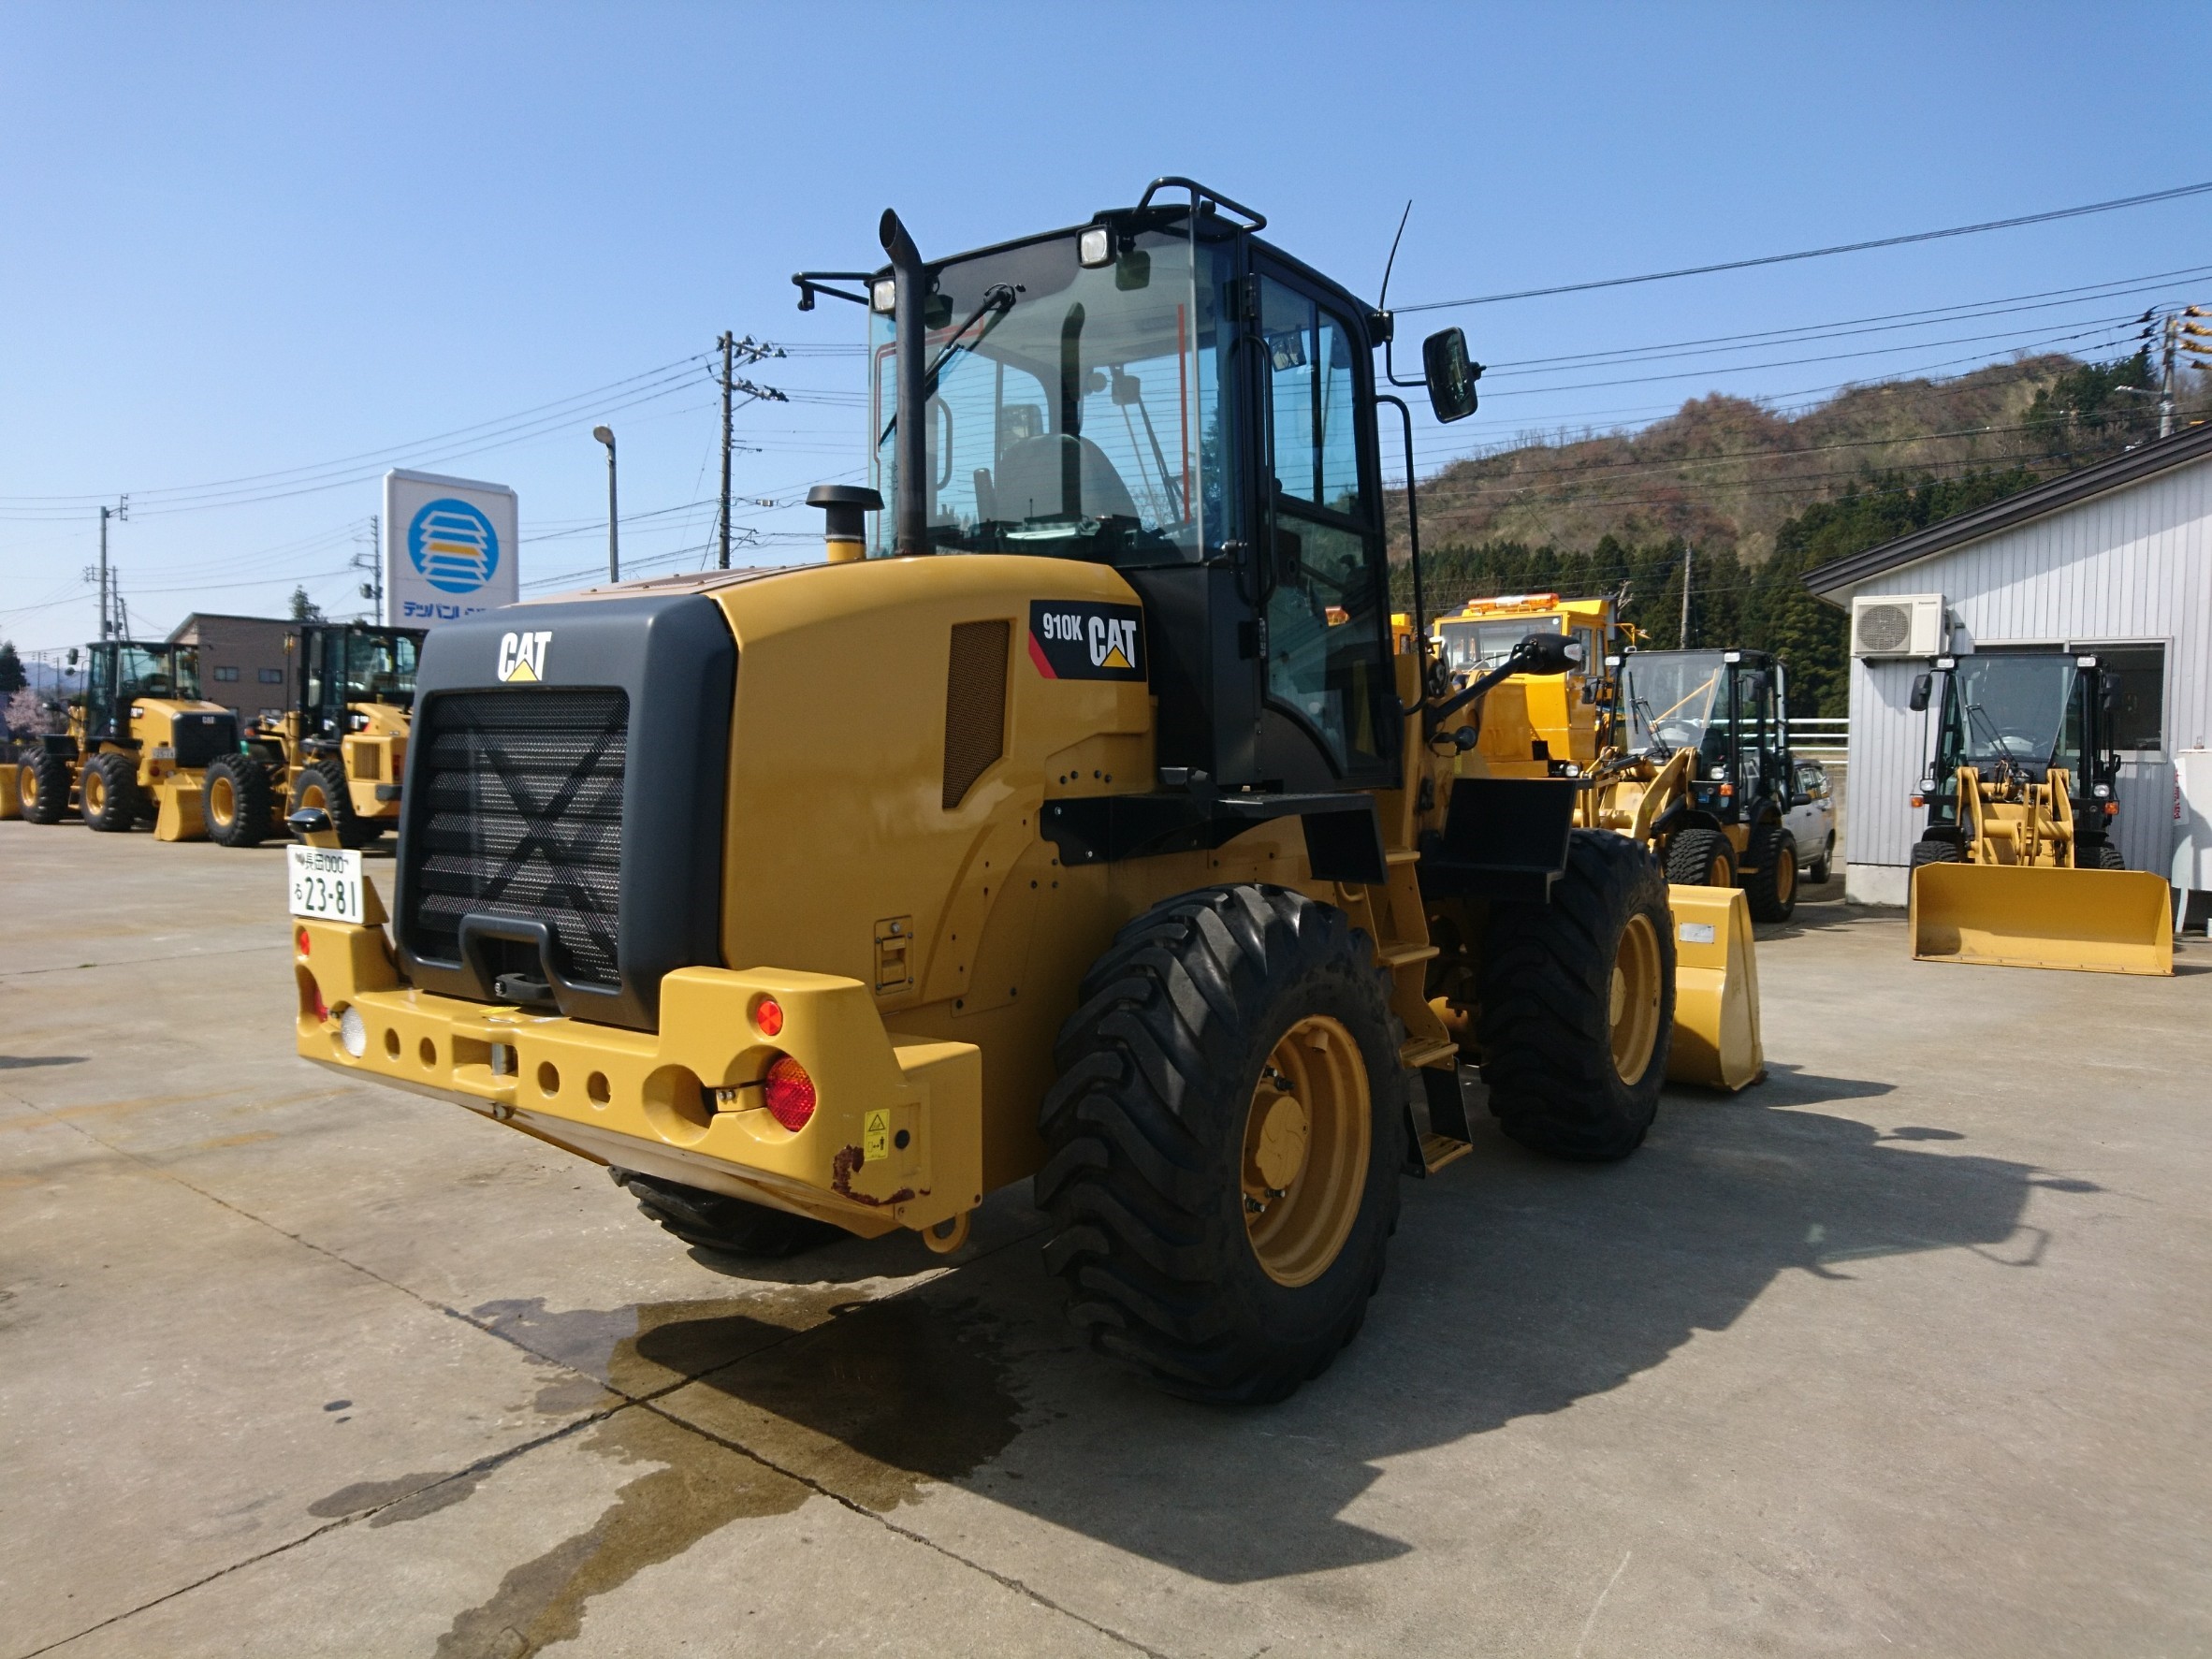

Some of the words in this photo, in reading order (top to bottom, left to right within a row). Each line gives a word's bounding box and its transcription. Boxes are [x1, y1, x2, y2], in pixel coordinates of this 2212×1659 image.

[498, 631, 553, 682] CAT
[1042, 612, 1084, 641] 910K
[1088, 616, 1137, 668] CAT
[304, 876, 357, 917] 23-81
